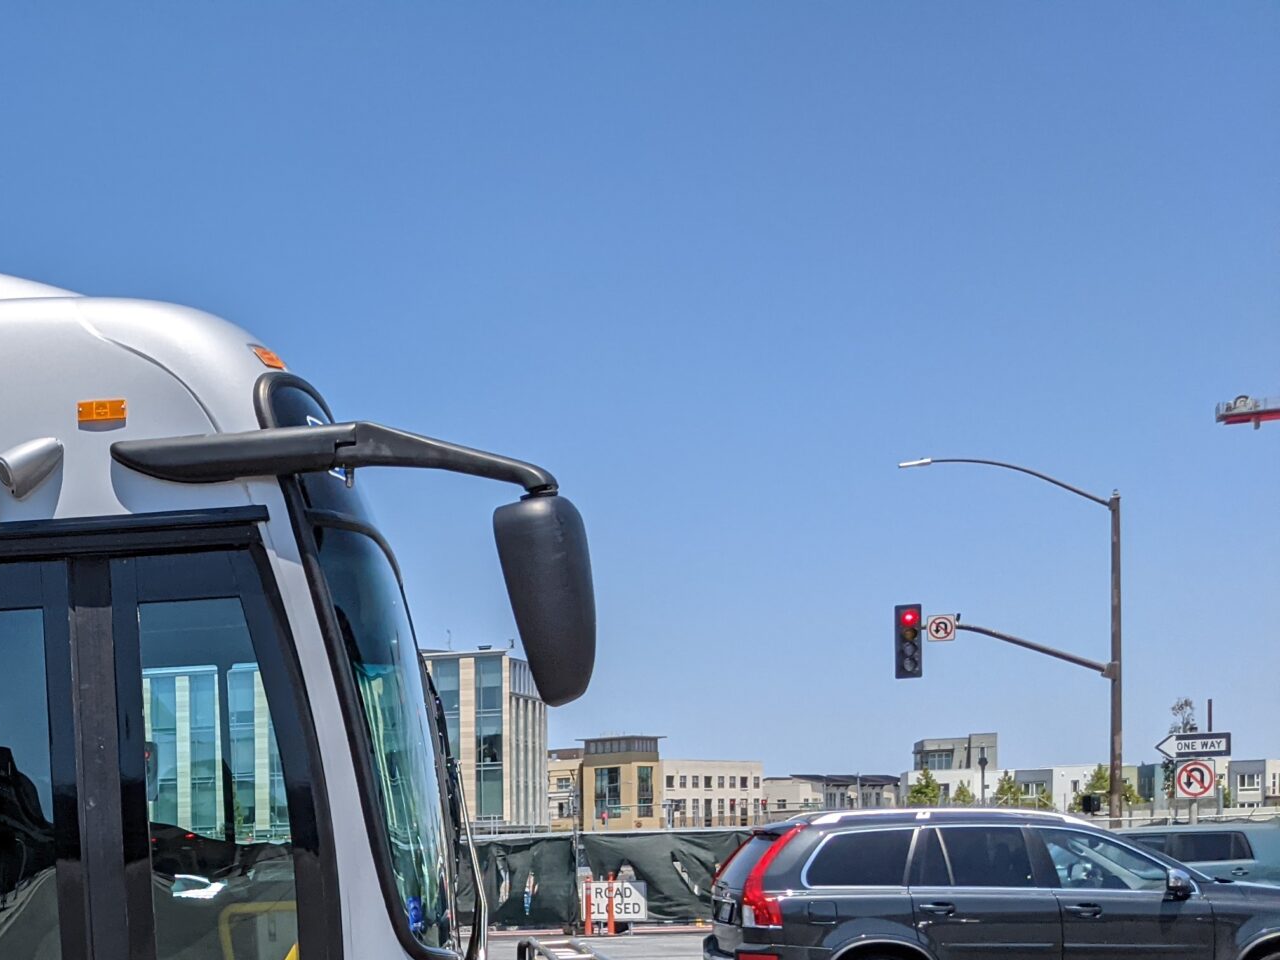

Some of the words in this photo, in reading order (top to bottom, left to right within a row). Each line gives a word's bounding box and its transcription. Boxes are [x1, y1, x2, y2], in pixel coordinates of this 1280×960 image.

[1176, 741, 1197, 751] ONE
[1200, 740, 1222, 750] WAY
[588, 903, 641, 914] LSED
